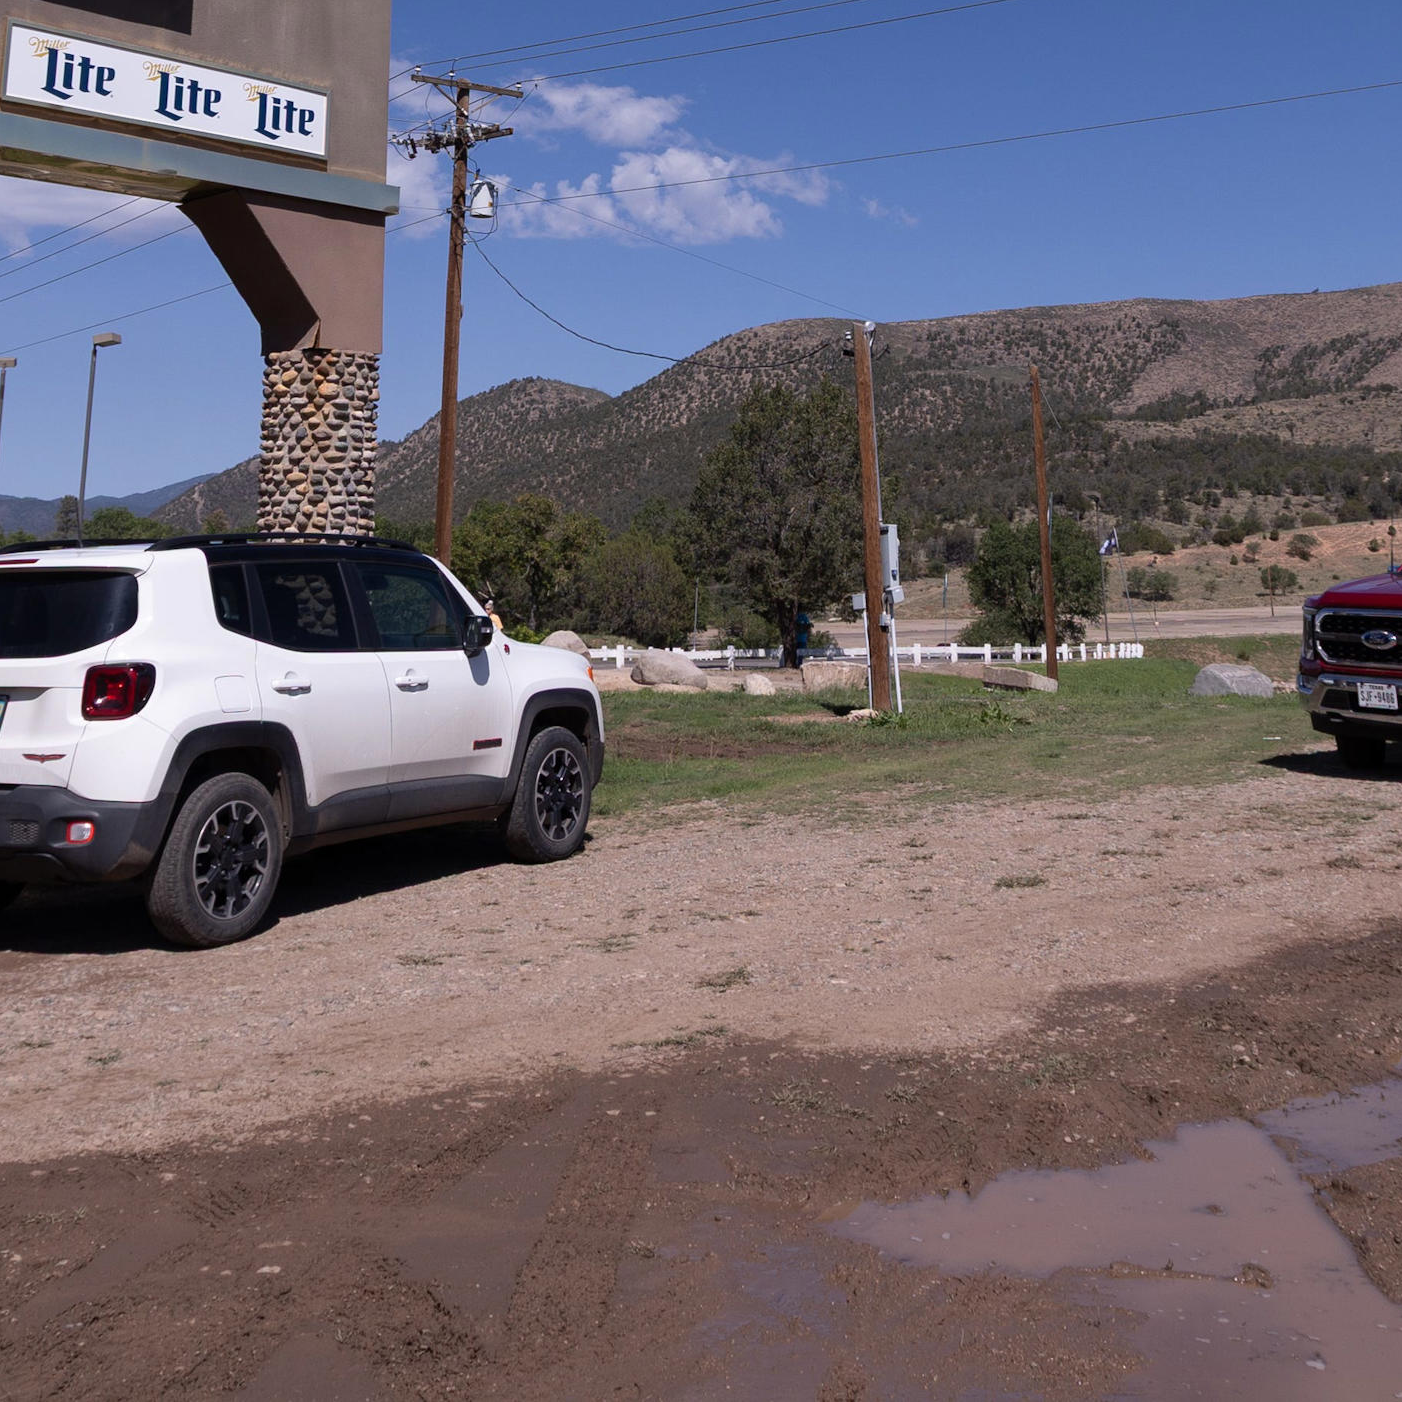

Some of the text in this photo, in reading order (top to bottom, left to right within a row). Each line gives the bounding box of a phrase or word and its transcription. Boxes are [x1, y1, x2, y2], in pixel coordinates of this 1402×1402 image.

[28, 36, 71, 55] Miller
[40, 46, 116, 101] Lite
[142, 61, 181, 79] Miller
[154, 70, 222, 122] Lite
[242, 82, 278, 99] Miller
[254, 91, 316, 140] Lite
